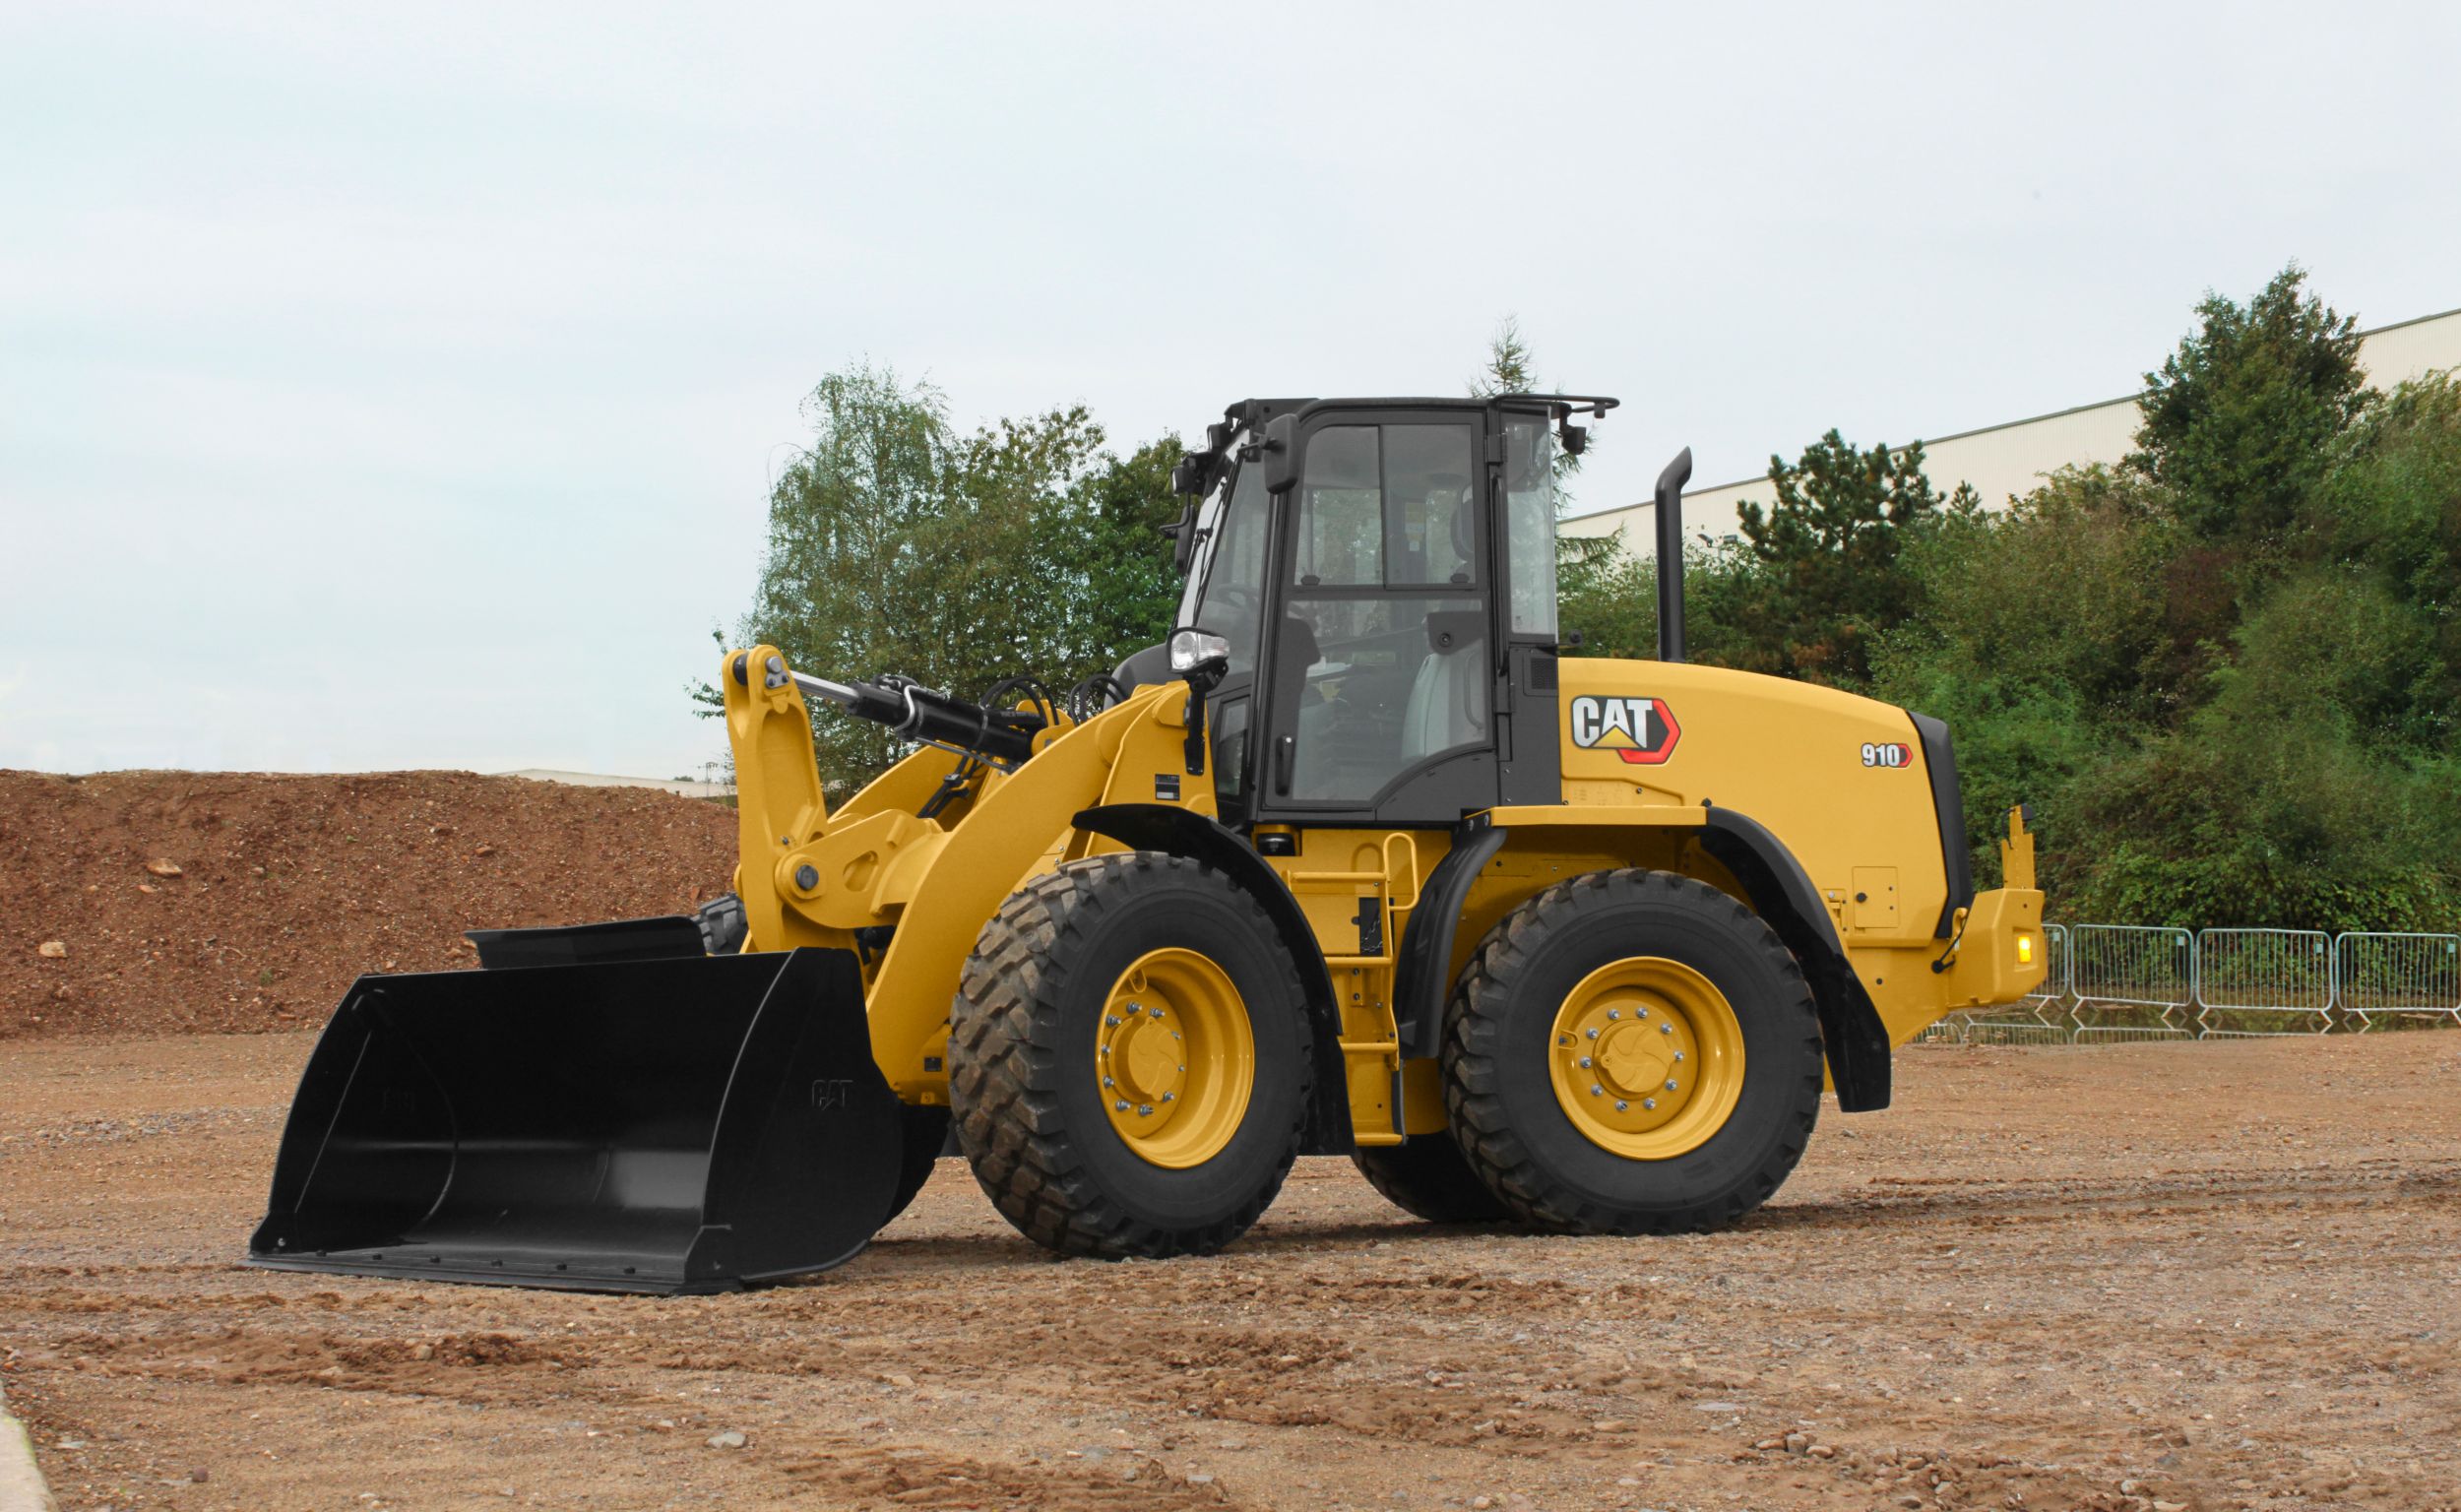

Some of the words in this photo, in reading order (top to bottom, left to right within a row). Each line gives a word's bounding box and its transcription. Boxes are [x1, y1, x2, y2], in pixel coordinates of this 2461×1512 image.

[1572, 697, 1653, 748] CAT
[1862, 743, 1900, 767] 910
[812, 1079, 853, 1110] CAT
